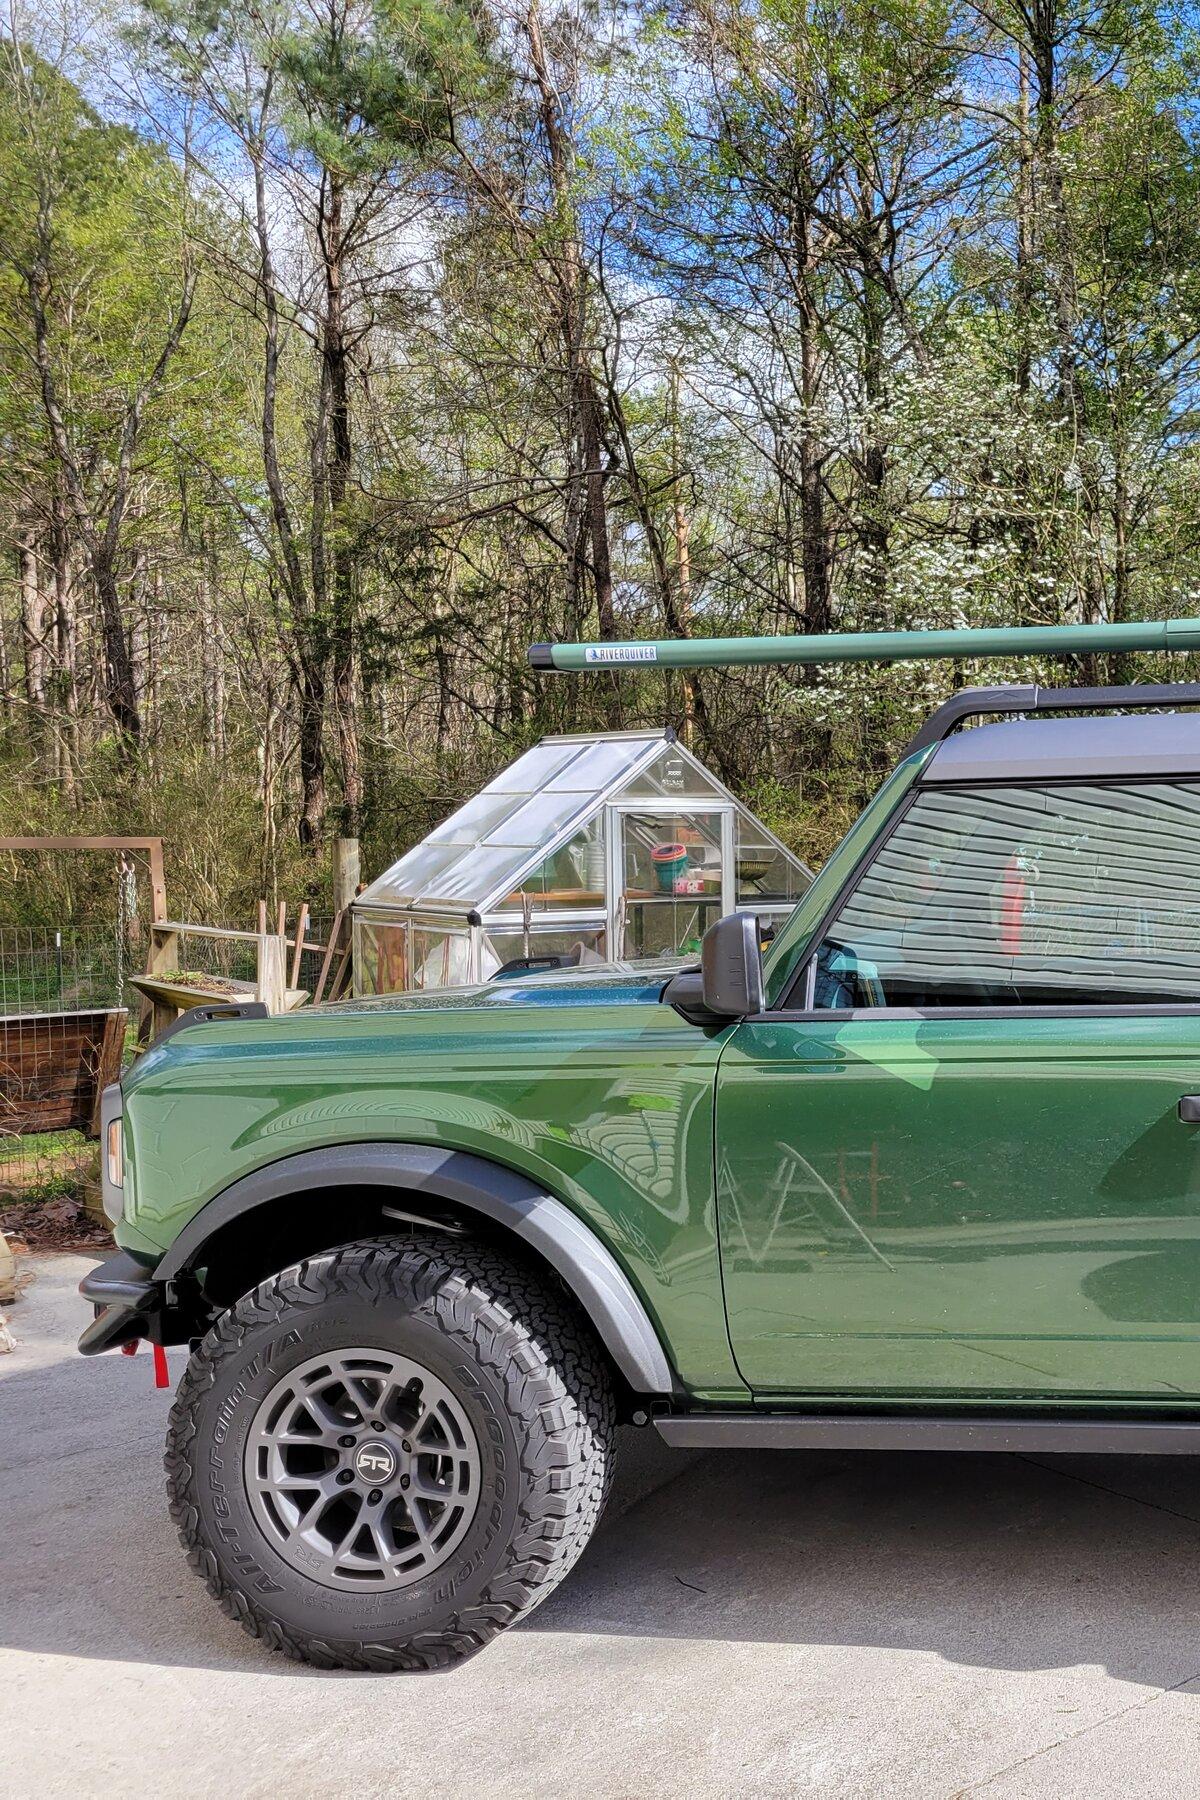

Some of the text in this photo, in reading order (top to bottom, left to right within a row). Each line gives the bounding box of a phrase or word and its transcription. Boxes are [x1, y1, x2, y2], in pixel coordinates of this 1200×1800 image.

[600, 647, 656, 660] RIVERQUIVER
[240, 1328, 304, 1381] T/A
[208, 1381, 287, 1593] All-Terrain
[433, 1364, 507, 1606] BFGoodrich
